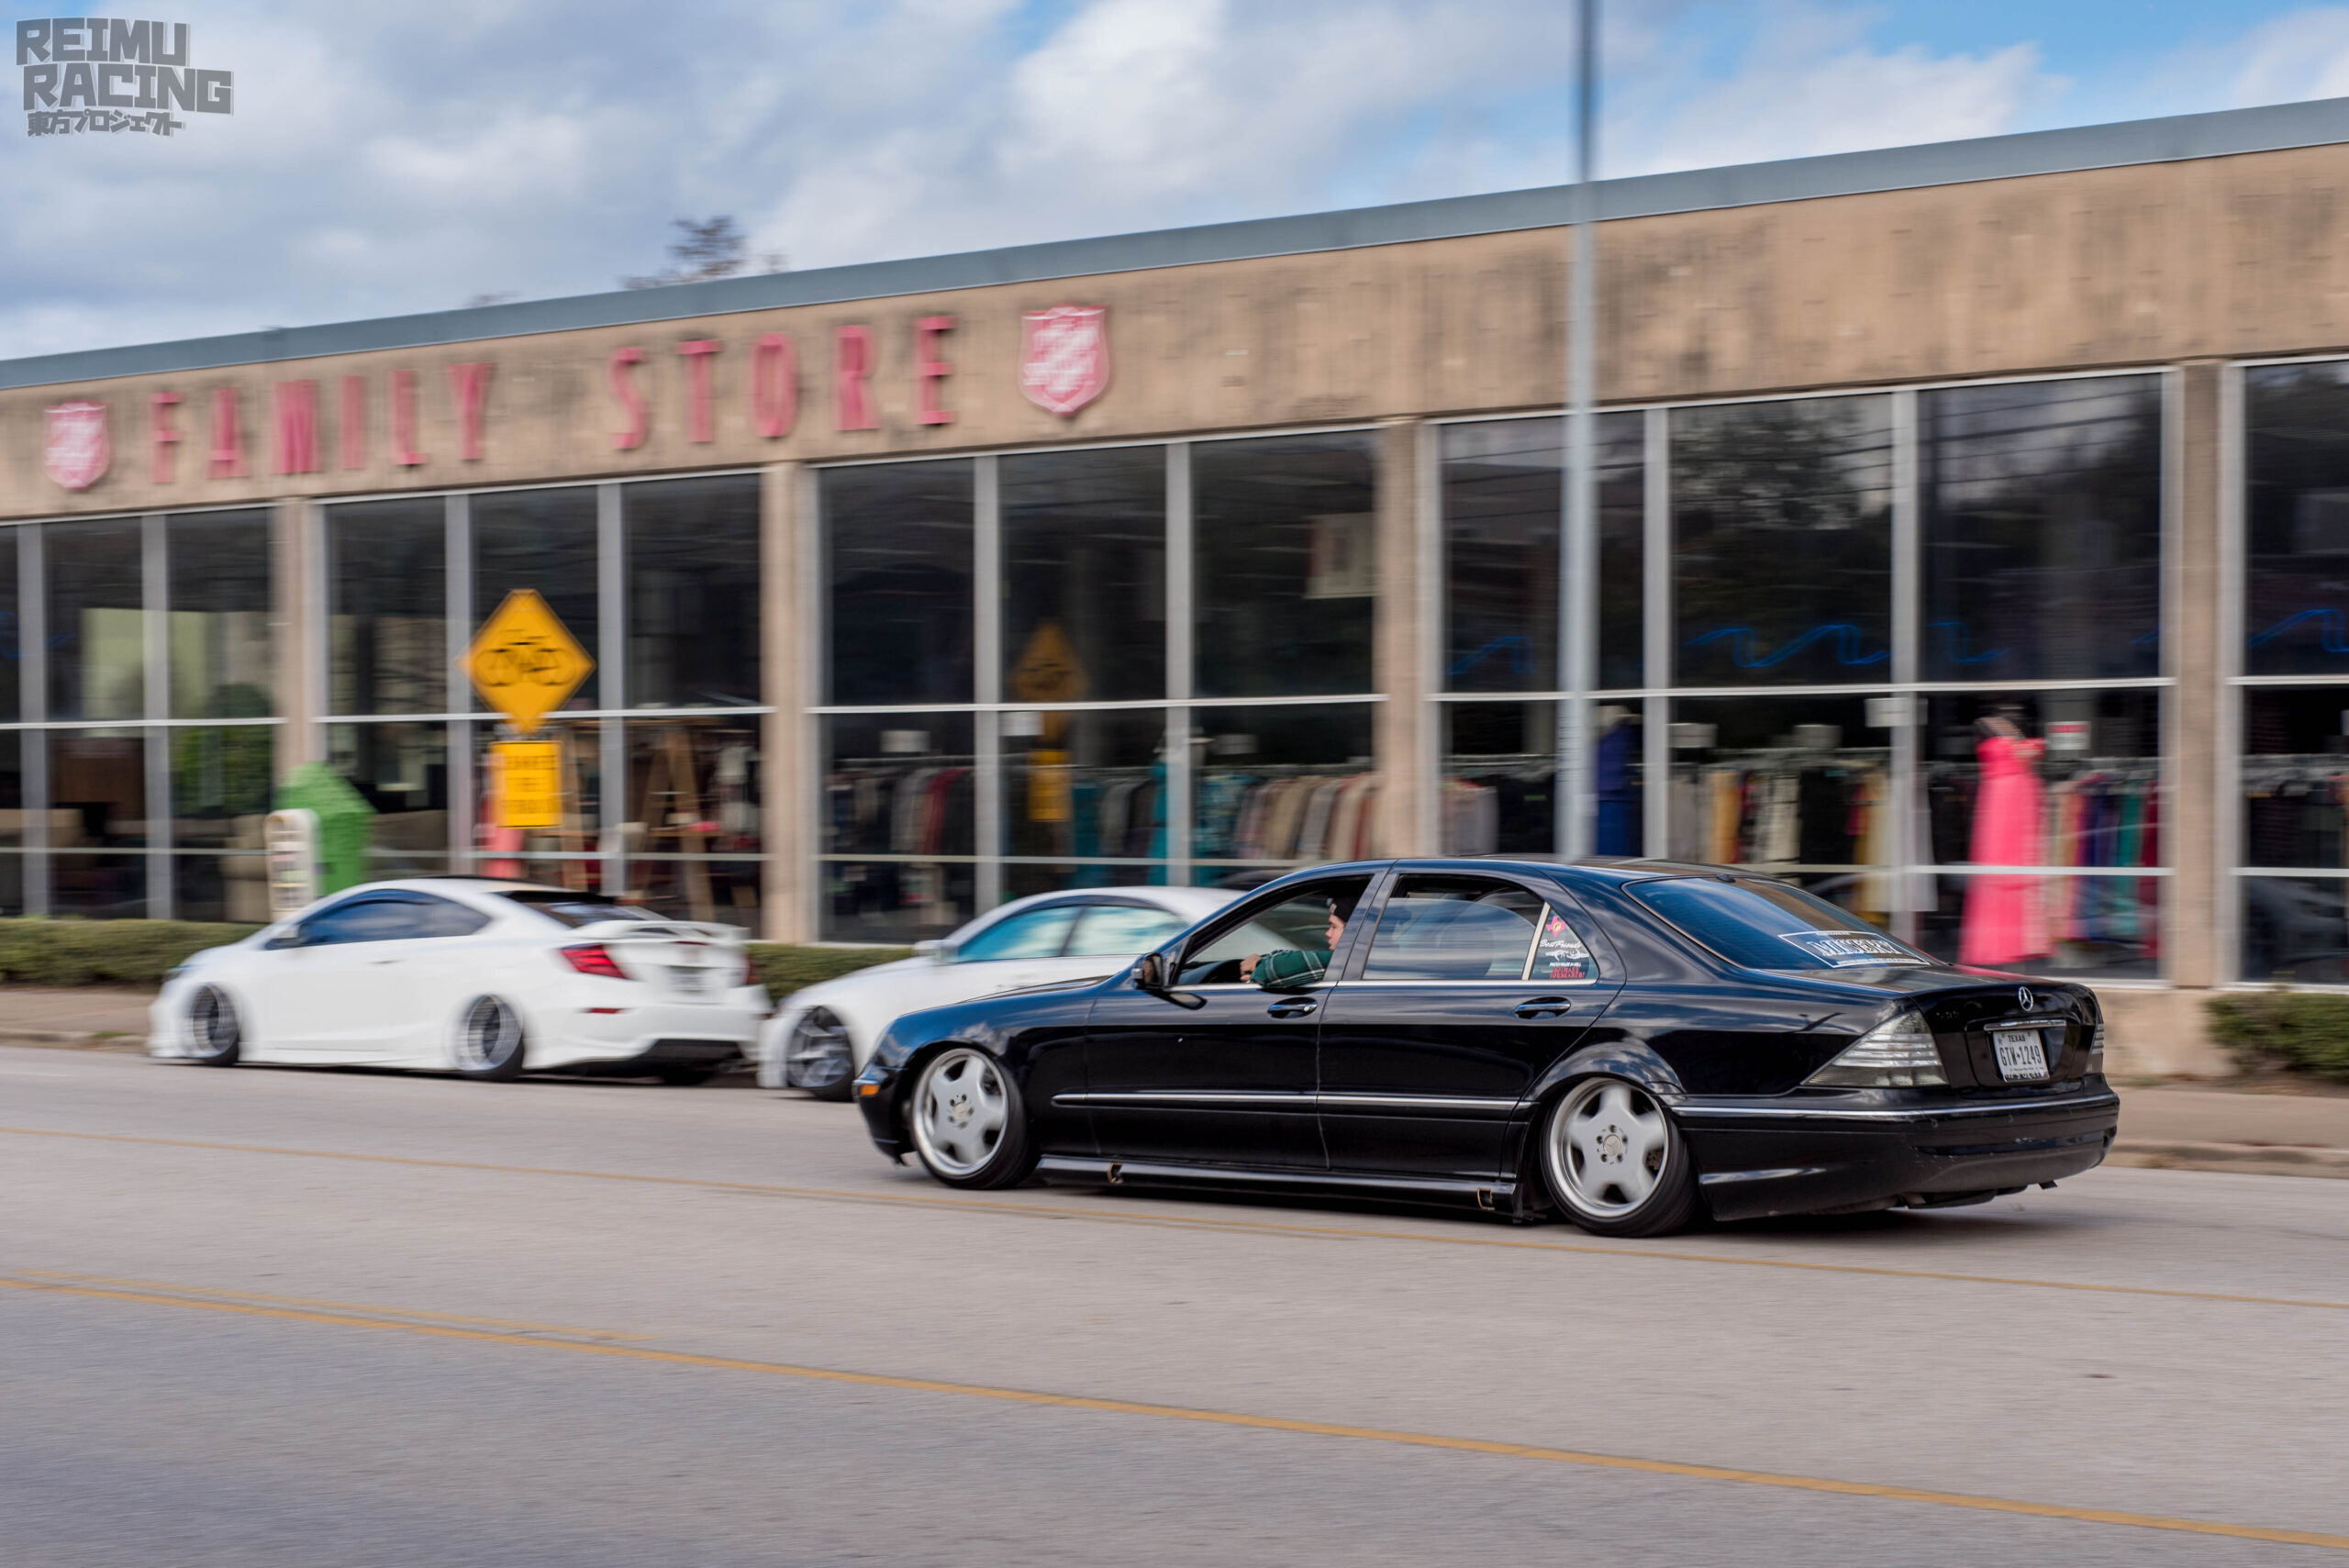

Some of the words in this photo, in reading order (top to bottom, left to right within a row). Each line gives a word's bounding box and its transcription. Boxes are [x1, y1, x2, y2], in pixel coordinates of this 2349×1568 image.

[150, 362, 495, 484] FAMILY
[610, 316, 955, 450] STORE
[2008, 1035, 2026, 1043] TEXAS
